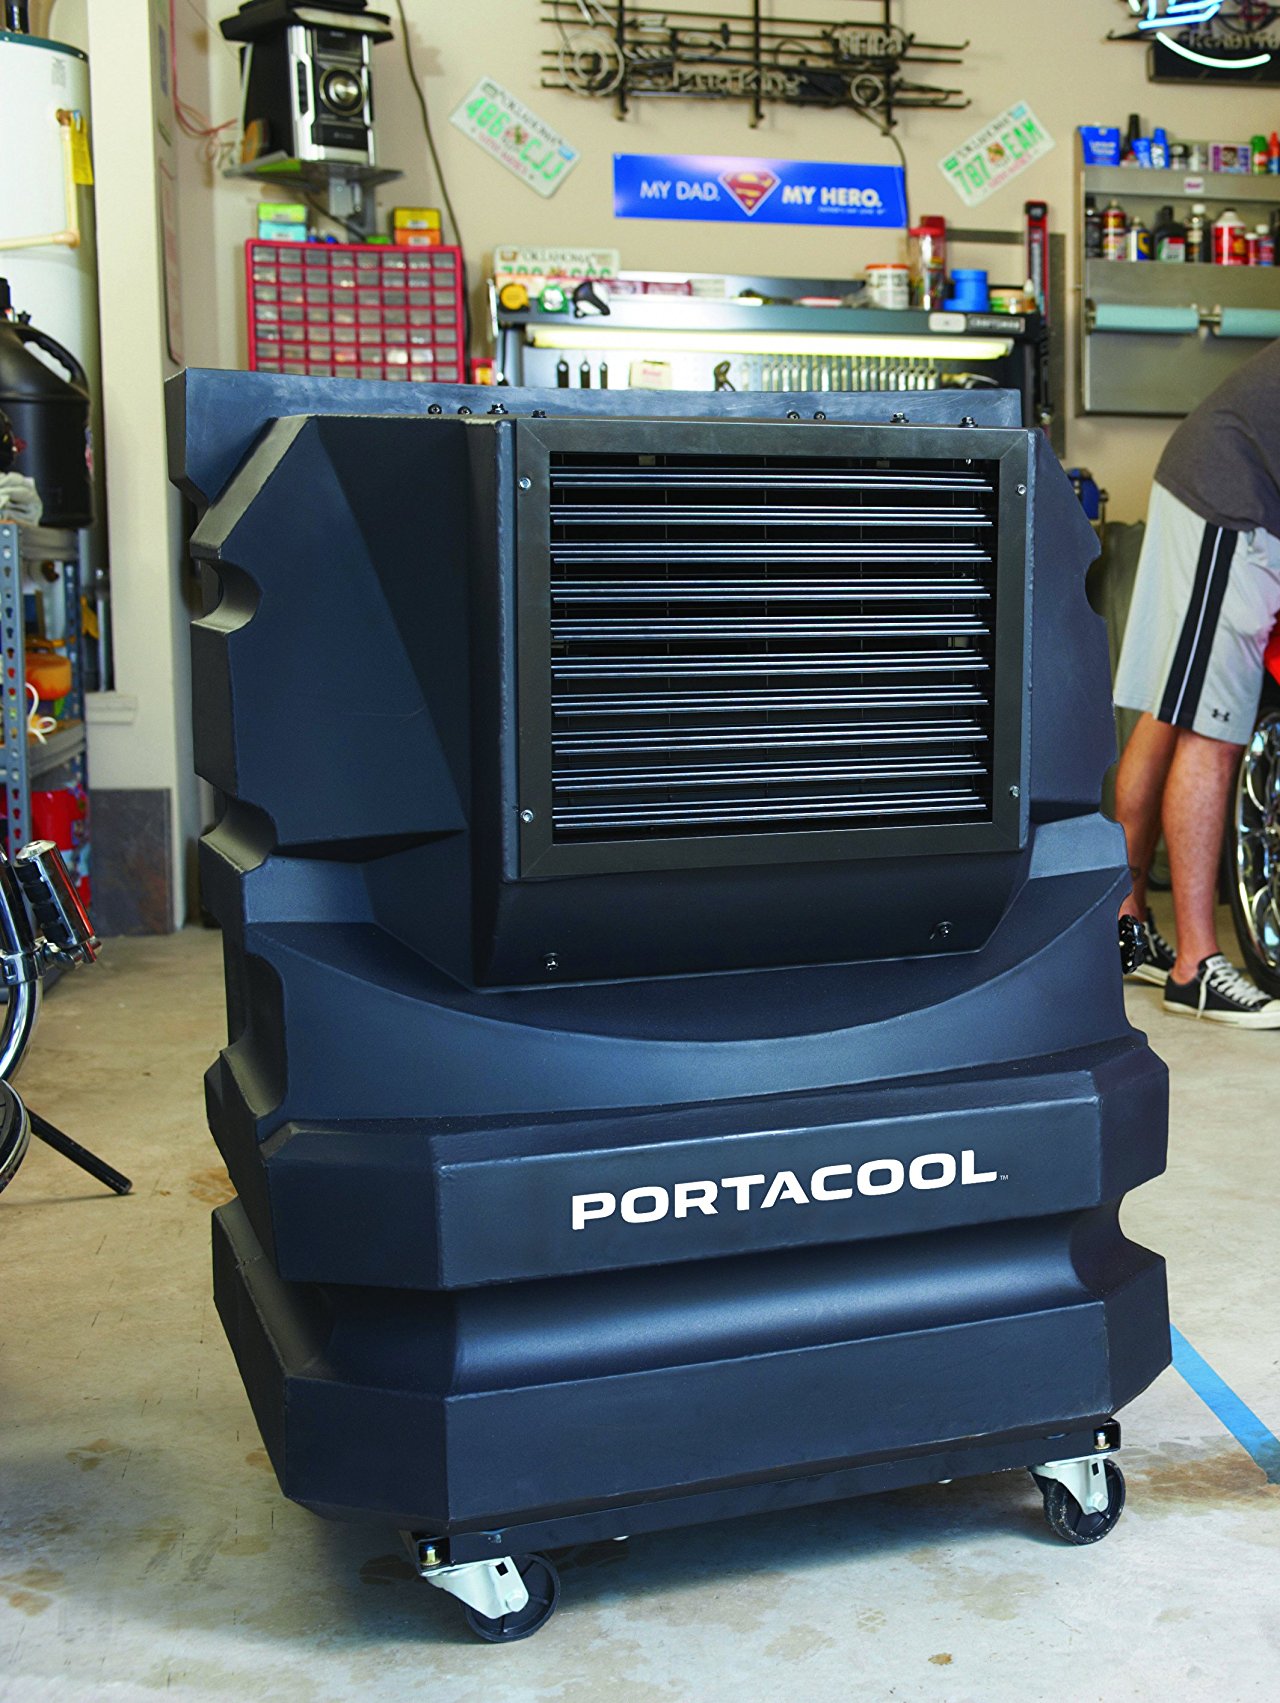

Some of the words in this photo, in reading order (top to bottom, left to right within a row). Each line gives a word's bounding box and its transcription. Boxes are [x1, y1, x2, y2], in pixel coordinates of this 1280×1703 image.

[640, 180, 672, 200] MY
[676, 181, 720, 202] DAD.
[782, 185, 816, 206] MY
[821, 187, 883, 209] HERO.
[571, 1149, 998, 1230] PORTACOOL
